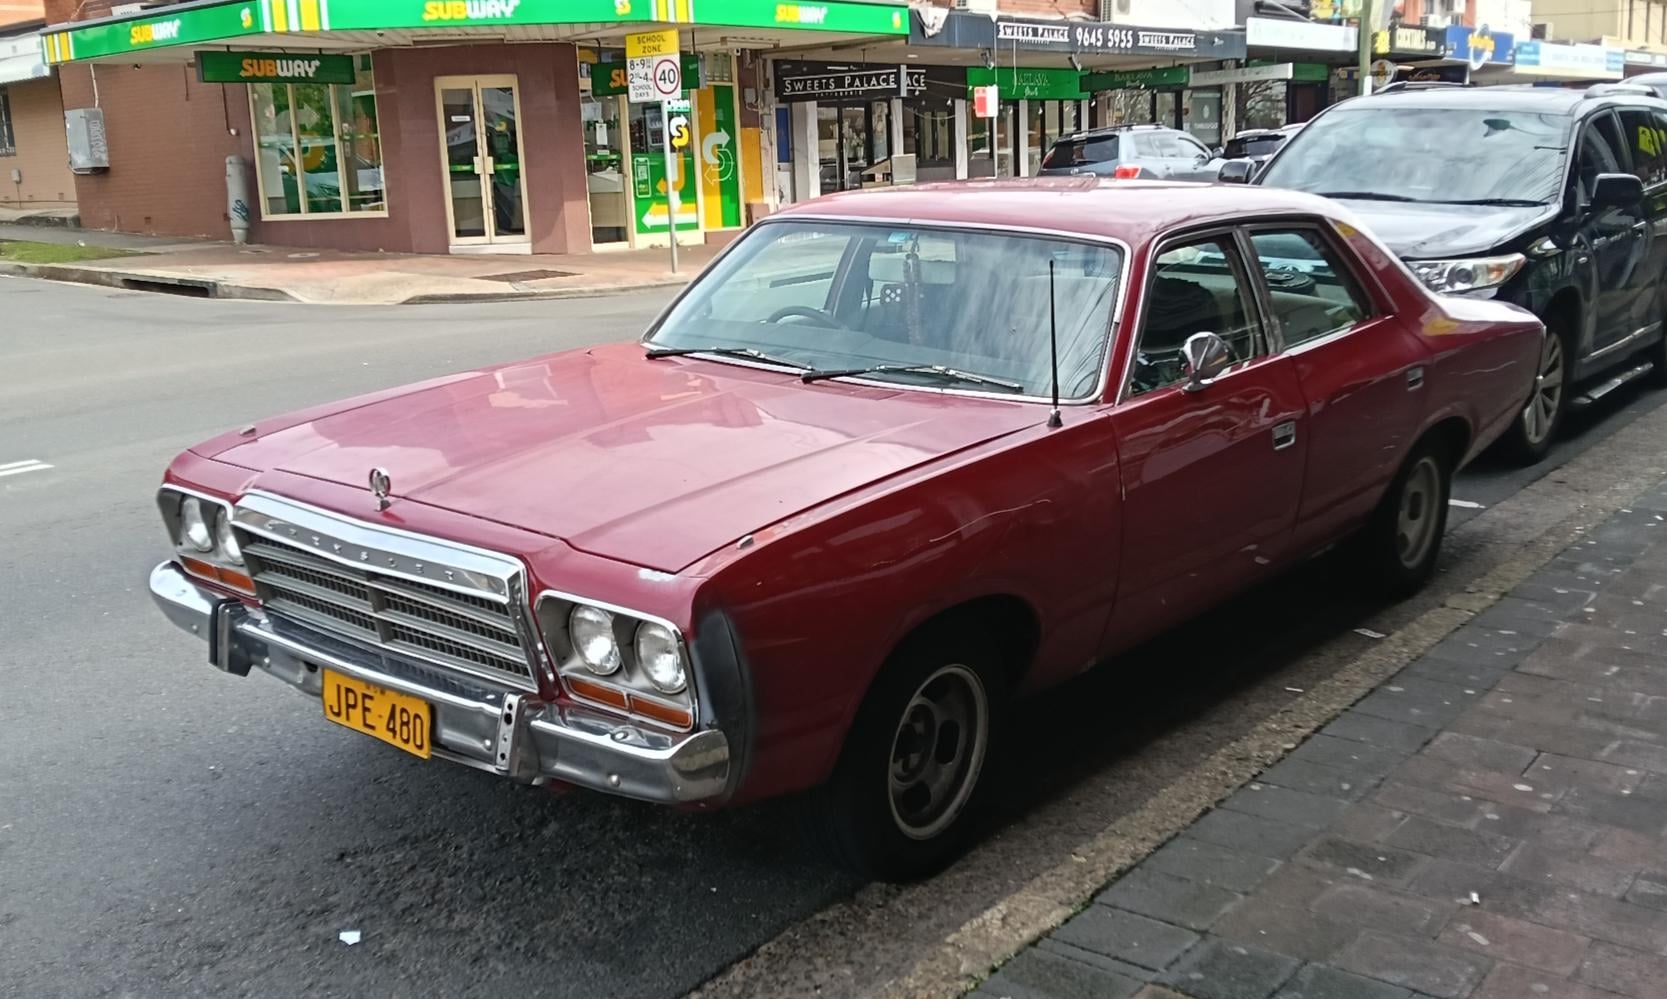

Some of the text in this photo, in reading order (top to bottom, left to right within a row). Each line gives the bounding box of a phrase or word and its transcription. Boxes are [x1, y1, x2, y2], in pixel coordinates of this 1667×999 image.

[423, 0, 519, 20] SUBWAY
[775, 4, 827, 24] SUBWAY
[130, 19, 181, 45] SUBWAY
[637, 35, 666, 44] SCHOOL
[999, 23, 1069, 40] SWEETS PALACE
[1076, 27, 1133, 48] 9645 5955
[1139, 32, 1195, 48] SWEETS PALACE
[642, 45, 662, 54] ZONE
[240, 59, 320, 77] SUBWAY
[658, 68, 676, 84] 40
[784, 74, 896, 92] SWEETS PALACE
